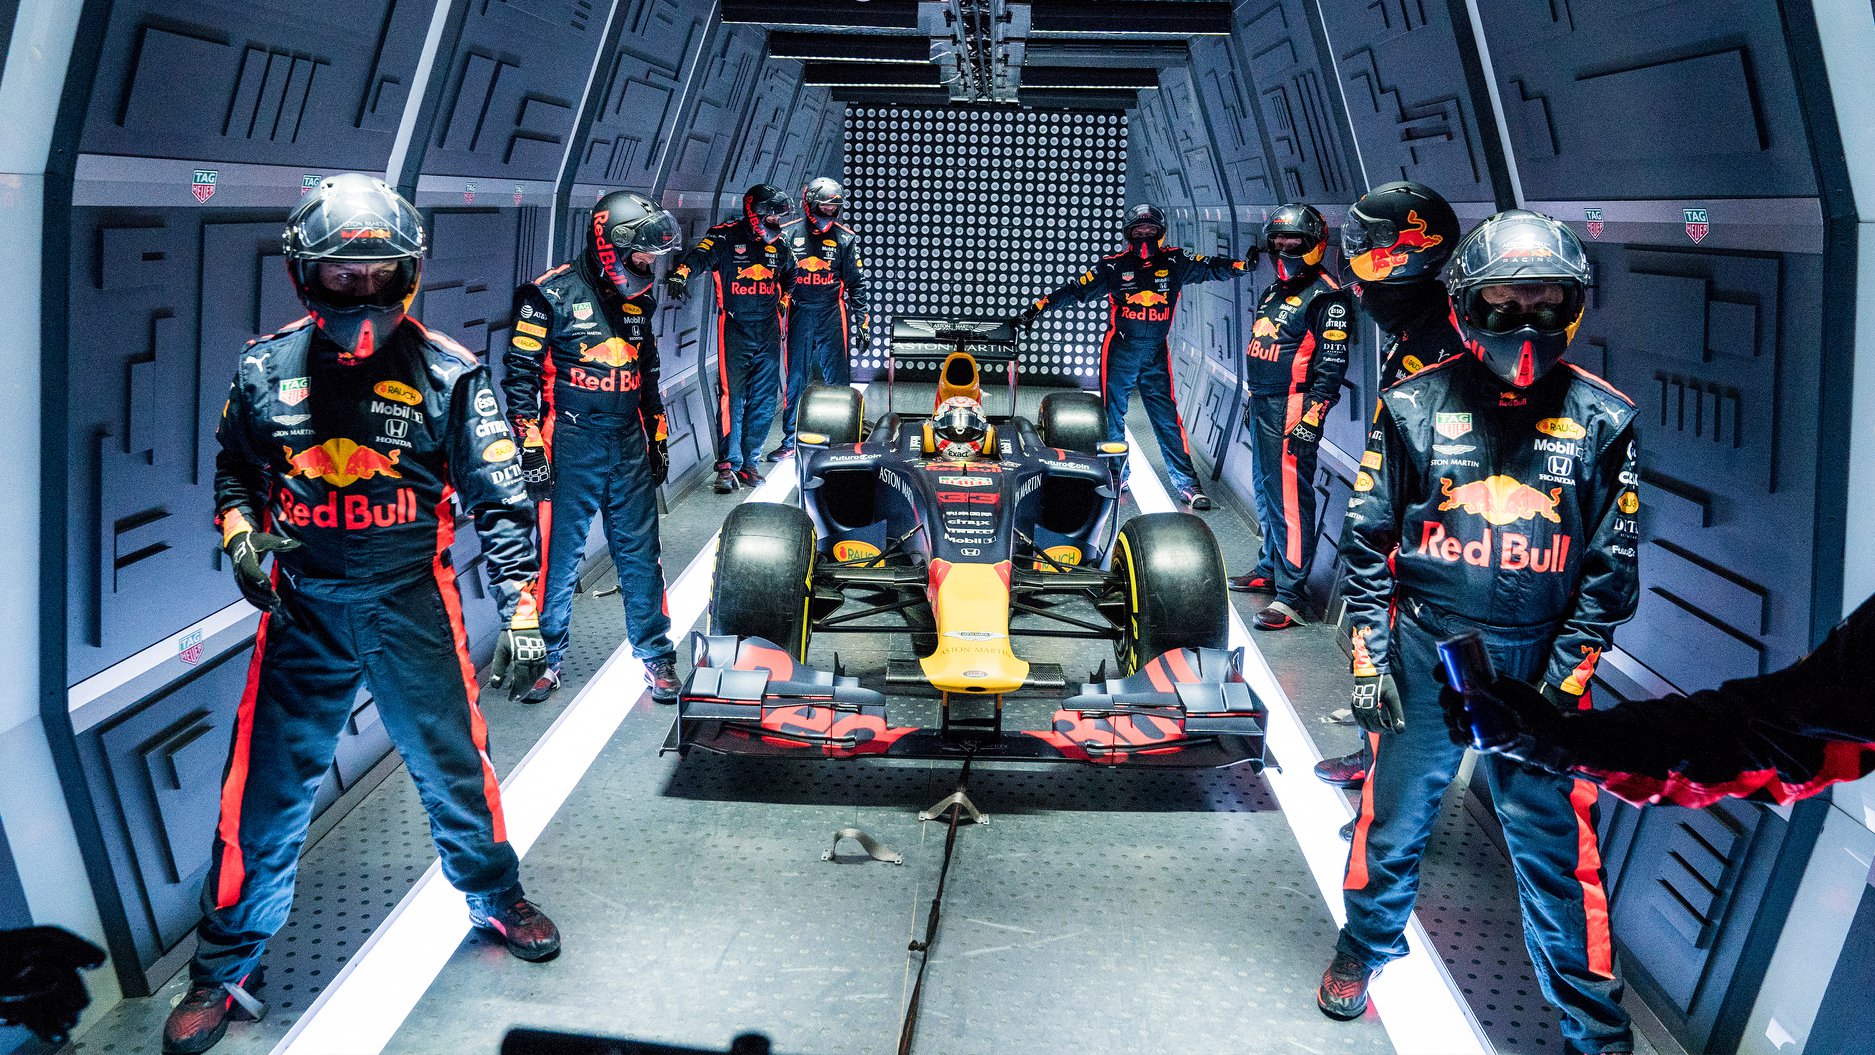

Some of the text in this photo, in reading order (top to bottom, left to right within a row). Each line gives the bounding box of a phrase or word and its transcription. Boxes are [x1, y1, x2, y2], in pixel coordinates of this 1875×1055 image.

[195, 172, 216, 183] TAG
[304, 177, 320, 186] TAG
[193, 185, 215, 200] HEUER
[1586, 211, 1602, 220] TAG
[1686, 211, 1706, 221] TAG
[1687, 223, 1708, 240] HEUER
[593, 209, 627, 285] Red Bull
[796, 272, 811, 284] ed
[731, 281, 757, 295] Red
[1121, 306, 1169, 321] Red Bull
[623, 316, 640, 324] Mobil
[892, 342, 950, 350] ASTON
[1250, 339, 1281, 362] Bull
[1323, 343, 1347, 351] DITA
[284, 379, 309, 390] TAG
[569, 368, 615, 392] Red
[388, 385, 416, 401] RAUCH
[371, 401, 410, 419] Mobil
[1438, 414, 1470, 424] TAG
[1437, 423, 1470, 435] HEUER
[375, 436, 412, 448] HONDA
[1534, 439, 1574, 456] Mobil
[830, 453, 882, 462] FuturoCoin
[1450, 459, 1479, 467] MARTIN
[1038, 459, 1090, 470] FuturoCoin
[879, 466, 900, 491] ASTON
[1538, 473, 1576, 486] HONDA
[1020, 473, 1042, 500] MARTIN
[278, 487, 417, 530] Red Bull
[944, 533, 982, 544] Mobil
[1416, 520, 1571, 573] Red Bull
[181, 632, 201, 650] TAG
[940, 647, 970, 656] ASTON
